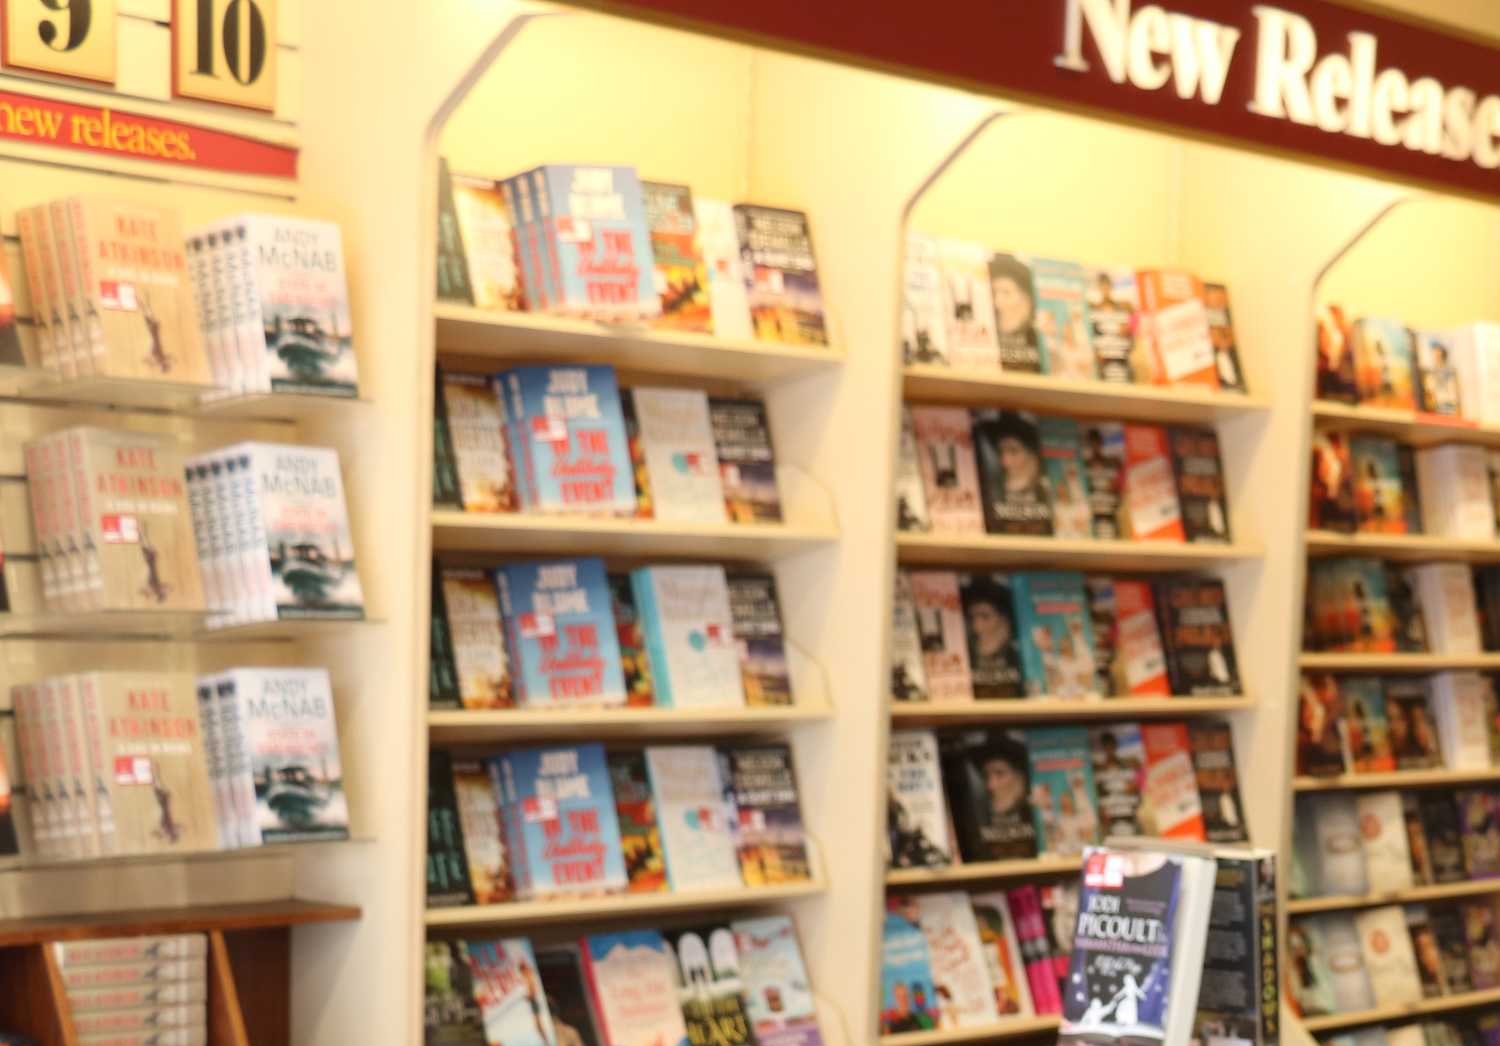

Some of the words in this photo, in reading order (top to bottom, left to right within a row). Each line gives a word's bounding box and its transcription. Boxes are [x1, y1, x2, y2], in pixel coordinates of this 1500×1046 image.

[189, 0, 267, 86] 10
[1053, 0, 1240, 104] New
[0, 104, 63, 139] new
[71, 110, 196, 161] releases.
[1078, 913, 1158, 942] PICOULT
